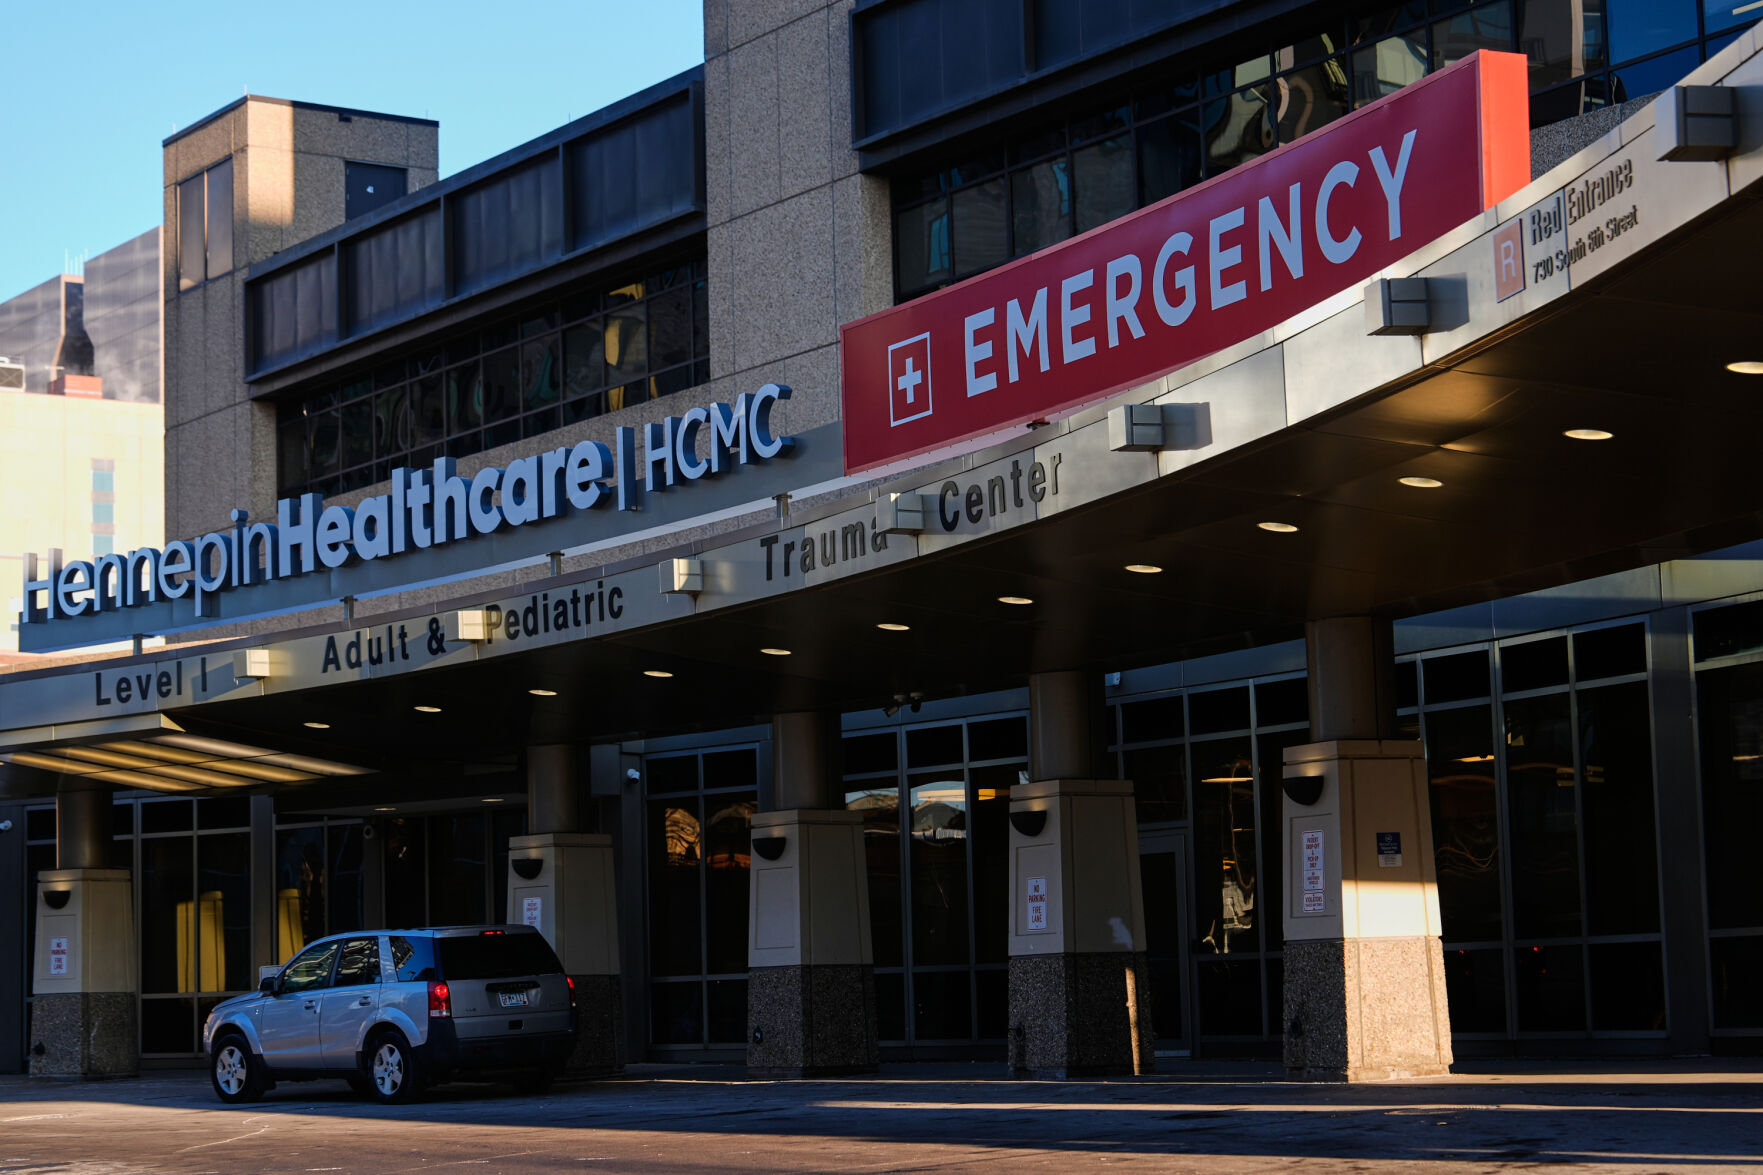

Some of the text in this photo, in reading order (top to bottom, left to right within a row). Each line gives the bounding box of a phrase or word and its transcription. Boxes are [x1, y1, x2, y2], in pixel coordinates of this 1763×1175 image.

[1530, 159, 1634, 246] Red Entrance
[965, 129, 1417, 398] EMERGENCY
[1501, 240, 1517, 282] R
[1532, 258, 1553, 284] 730
[1555, 238, 1587, 272] South
[1606, 205, 1639, 242] Street
[22, 440, 612, 623] HennepinHealthcare
[644, 383, 792, 492] HCMC
[95, 660, 183, 706] Level
[322, 626, 409, 674] Adult
[427, 617, 447, 656] &
[486, 581, 624, 644] Pediatric
[760, 518, 888, 581] Trauma
[939, 453, 1062, 532] Center
[1028, 894, 1046, 903] PARKING
[1032, 905, 1042, 914] FIRE
[1032, 914, 1043, 923] LANE
